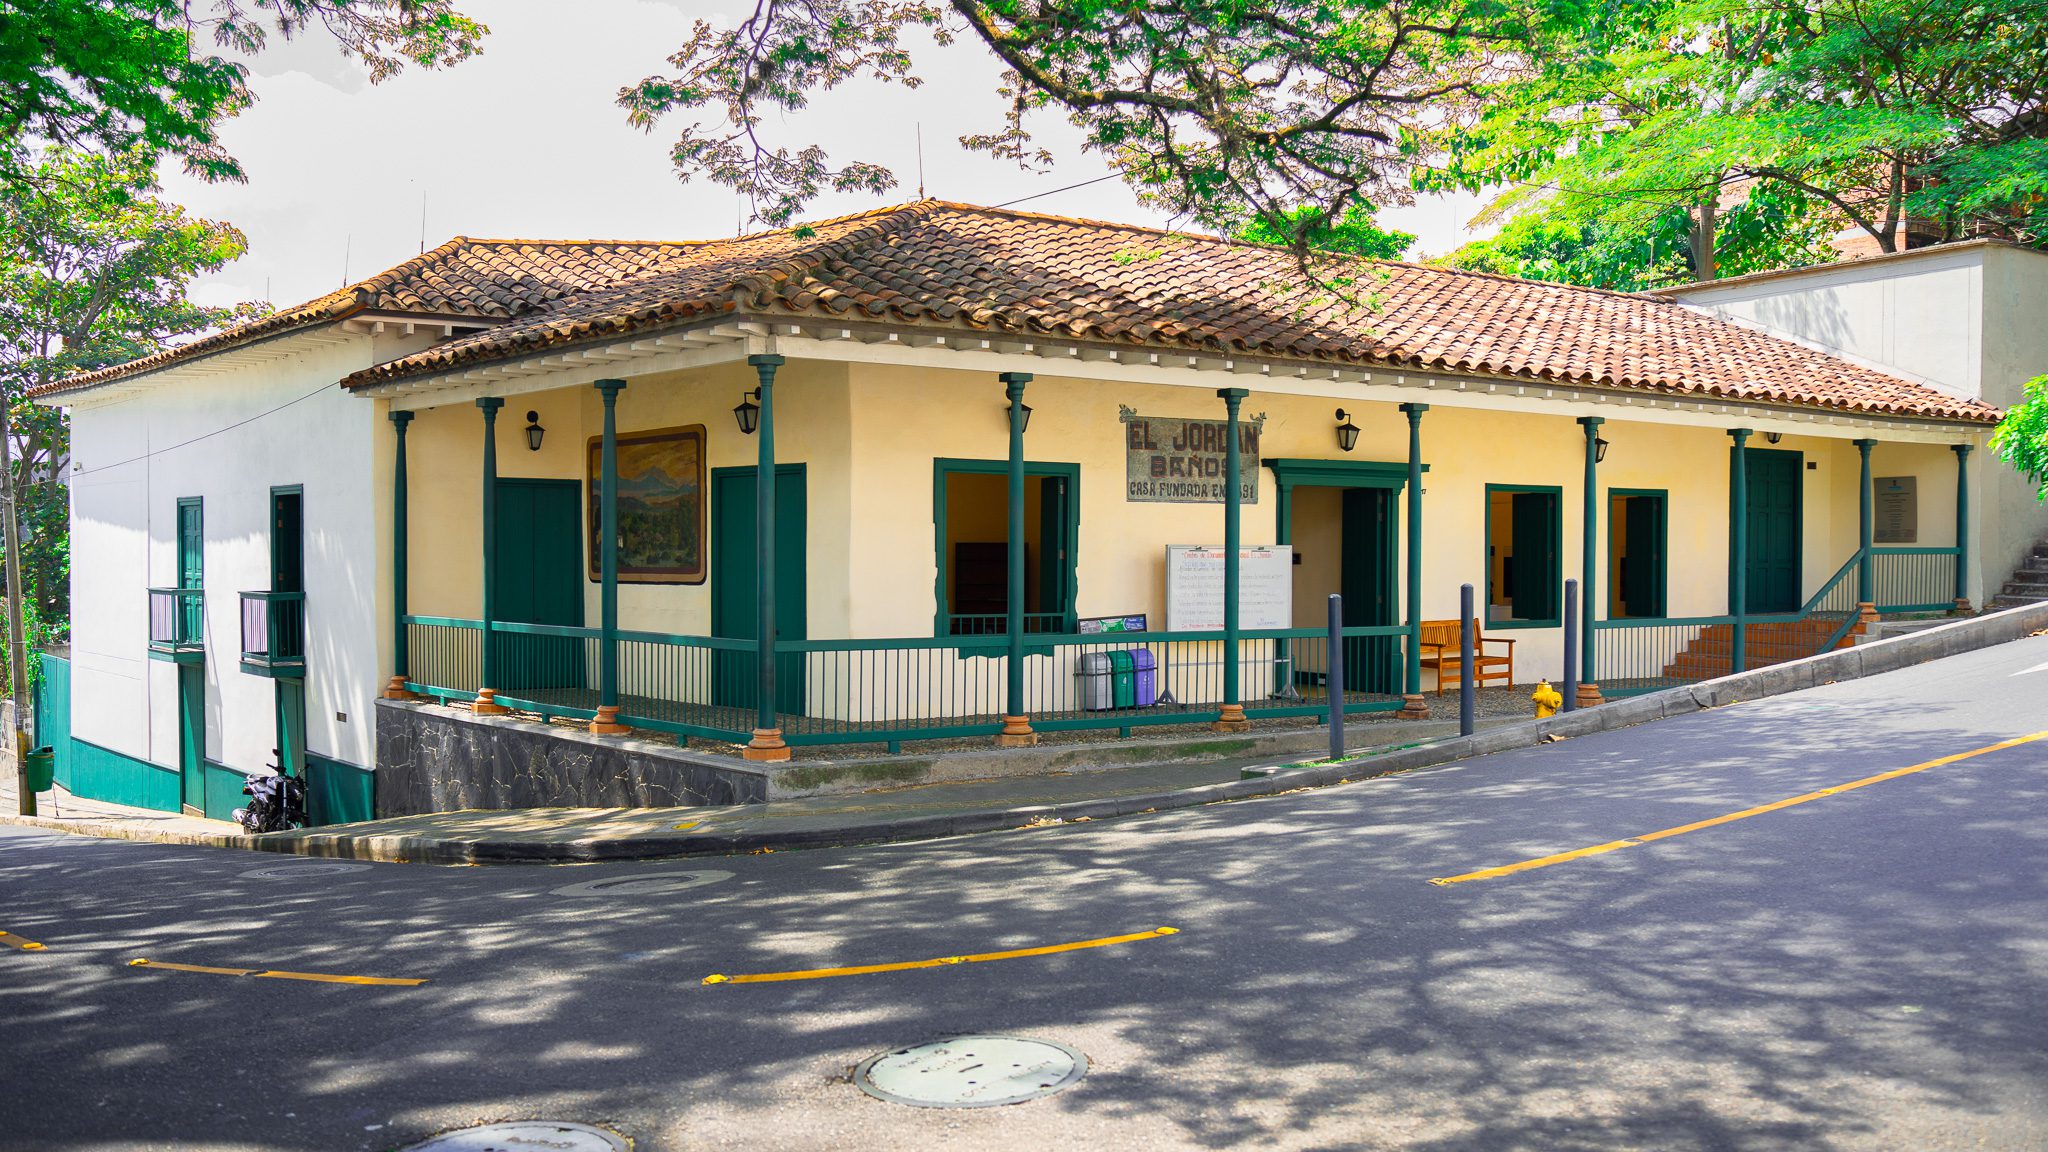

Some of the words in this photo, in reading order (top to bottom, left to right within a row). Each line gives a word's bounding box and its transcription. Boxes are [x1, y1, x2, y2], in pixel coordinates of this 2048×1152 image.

[1130, 421, 1157, 450] EL
[1130, 481, 1156, 496] CASA
[1160, 482, 1208, 497] FUNDADA
[1212, 483, 1226, 498] EN
[1239, 484, 1255, 498] 91
